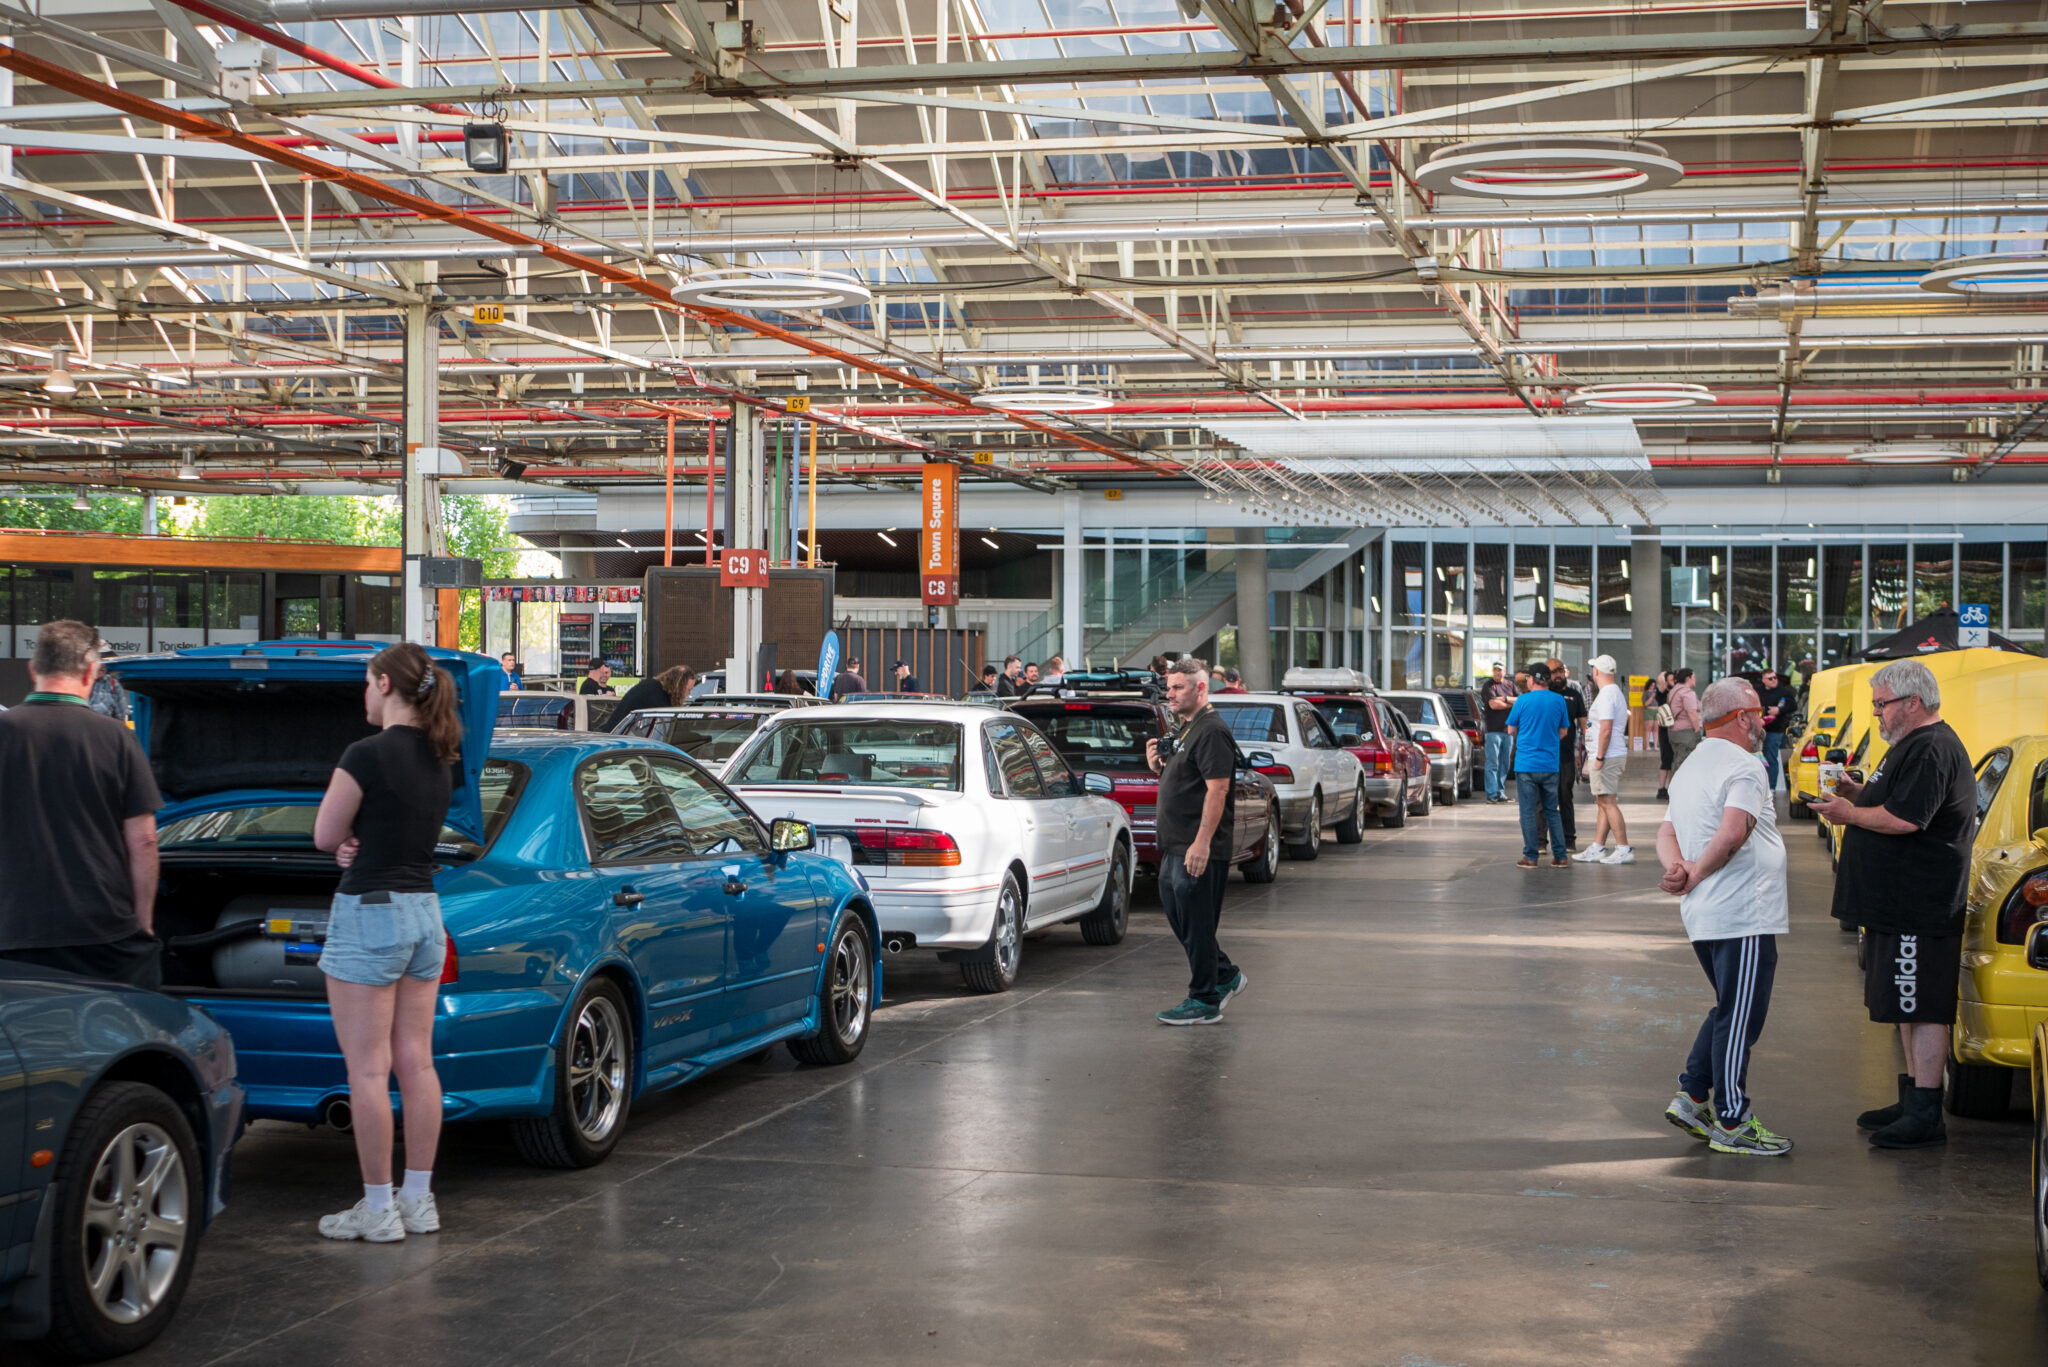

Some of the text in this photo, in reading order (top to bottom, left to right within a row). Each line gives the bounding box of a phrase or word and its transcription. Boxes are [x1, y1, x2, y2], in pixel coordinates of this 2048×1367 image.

[479, 307, 499, 320] C10
[792, 399, 804, 409] C9
[929, 478, 944, 569] Town Square
[728, 555, 750, 575] C9
[928, 580, 946, 596] C8
[106, 640, 141, 653] onsley
